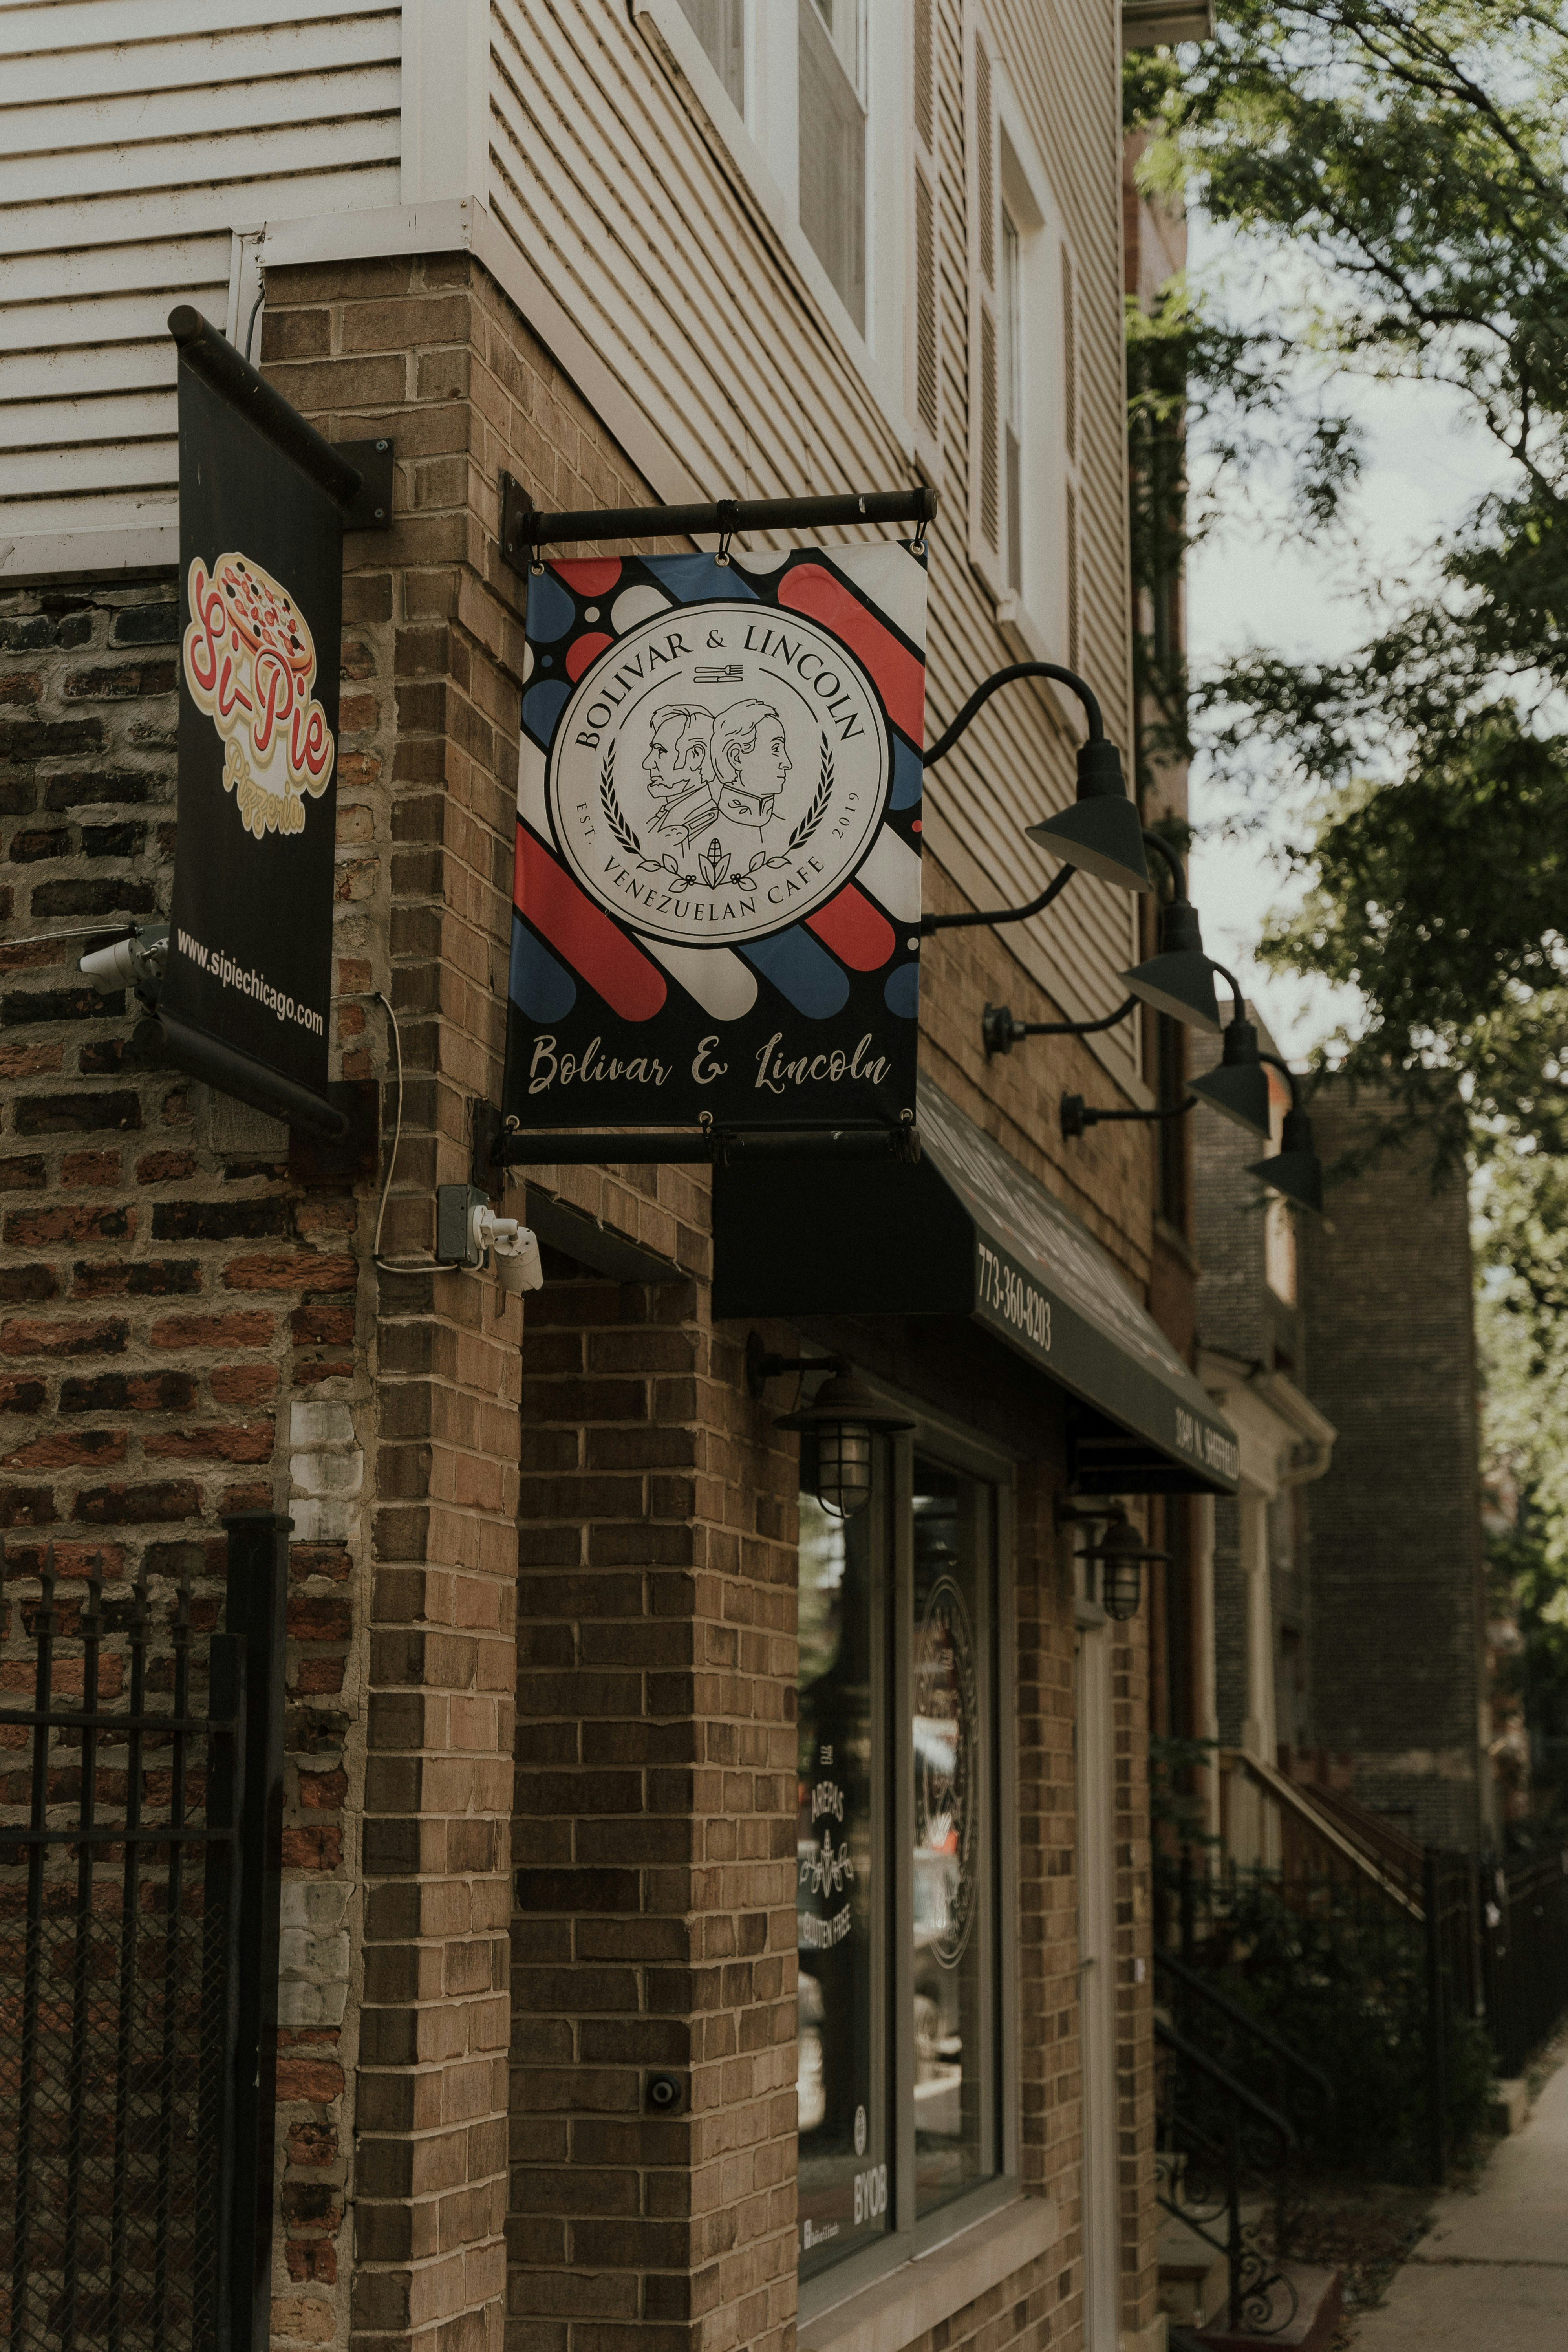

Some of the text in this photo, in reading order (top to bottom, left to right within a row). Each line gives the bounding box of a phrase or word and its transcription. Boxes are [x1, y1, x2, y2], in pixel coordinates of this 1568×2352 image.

[575, 624, 866, 750] BOLIVAR & LINCOLN
[224, 738, 304, 835] Pizzeria
[576, 792, 859, 846] EST. 2019
[603, 855, 824, 921] VENEZUELAN CAFE
[178, 928, 323, 1036] www.sipiechicago.com
[528, 1032, 891, 1094] Bolivar & Lincoln
[978, 1242, 1051, 1352] 773-360-8203
[811, 1780, 844, 1823] AREPAS
[803, 1902, 851, 1949] GLUTEN FREE
[854, 2163, 887, 2226] BYOB
